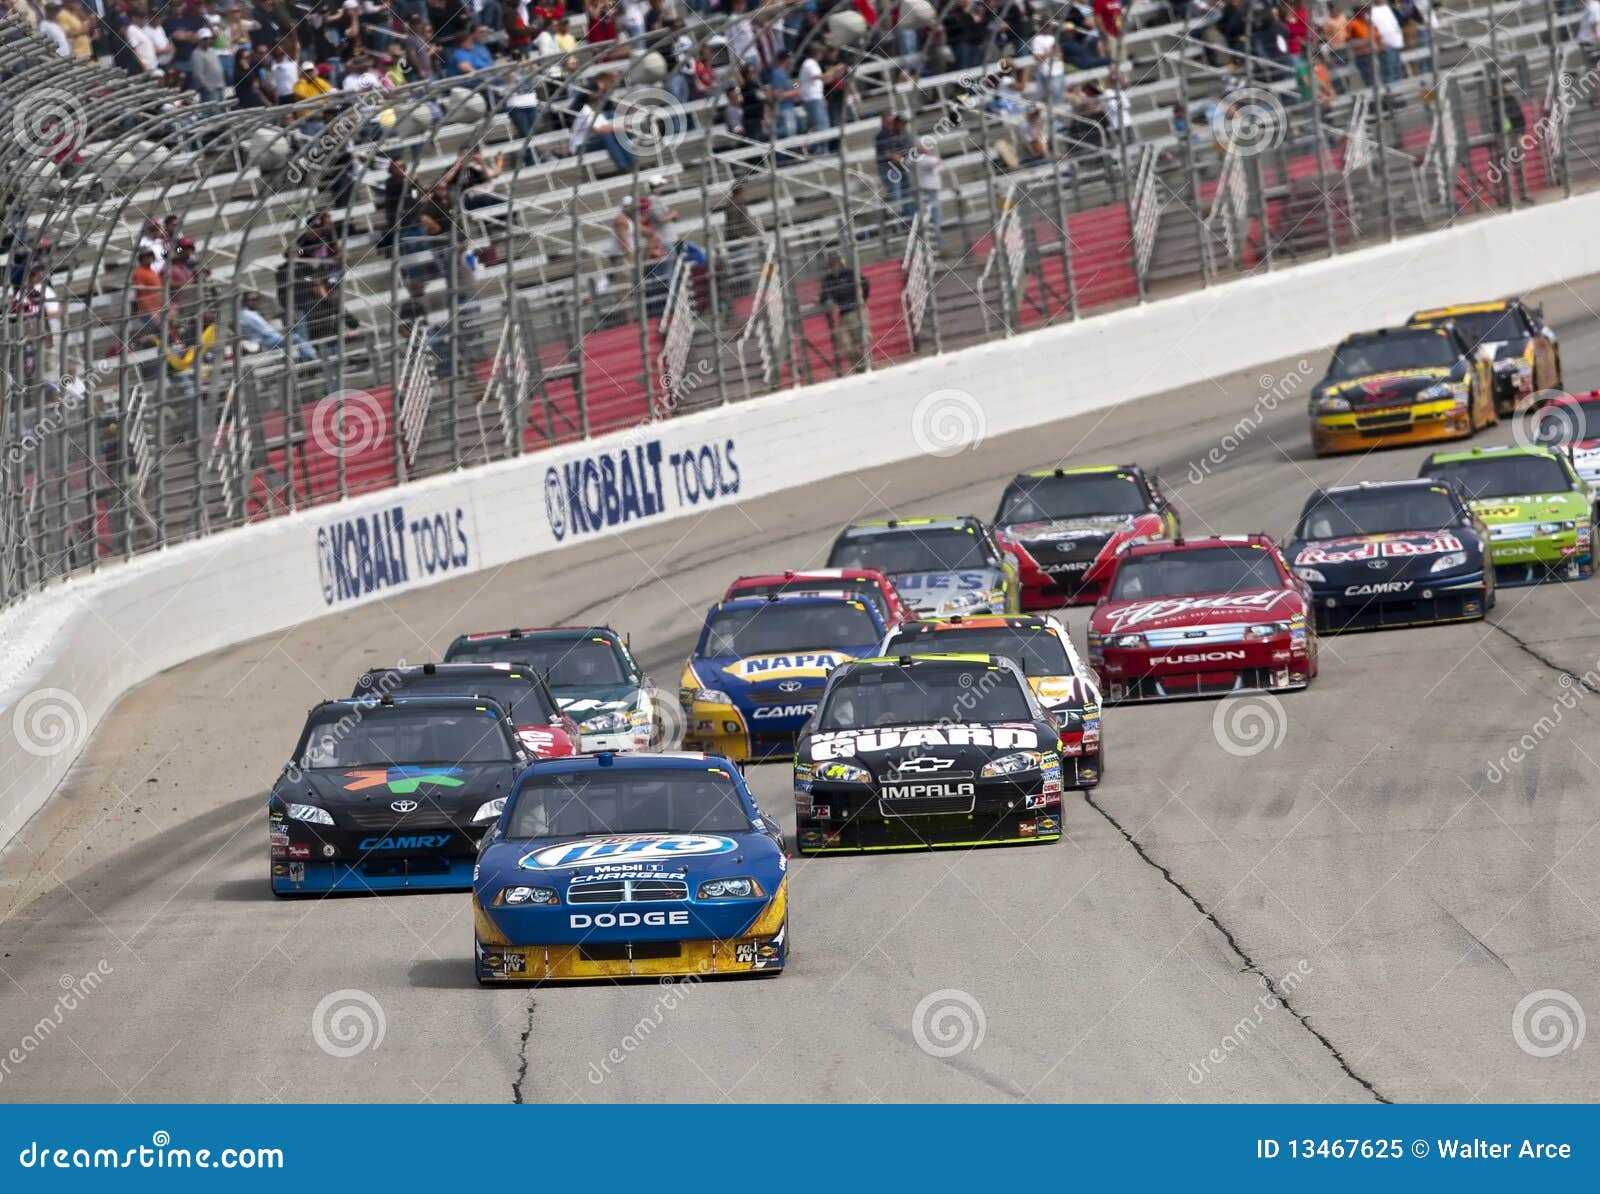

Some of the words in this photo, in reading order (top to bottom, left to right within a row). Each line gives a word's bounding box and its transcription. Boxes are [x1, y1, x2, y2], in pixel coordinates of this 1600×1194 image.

[564, 440, 666, 535] KOBALT
[669, 439, 741, 508] TOOLS
[331, 506, 408, 602] KOBALT
[410, 508, 469, 578] TOOLS
[1294, 542, 1378, 566] Red
[1381, 536, 1463, 558] Bull
[1344, 580, 1414, 597] CAMRY
[746, 654, 836, 674] NAPA
[1149, 650, 1246, 666] FUSION
[752, 704, 818, 719] CAMR
[811, 728, 1038, 761] GUARD
[882, 782, 974, 799] IMPALA
[358, 834, 452, 850] CAMRY
[594, 864, 643, 873] Mobil
[570, 872, 687, 884] CHARGER
[570, 911, 689, 929] DODGE
